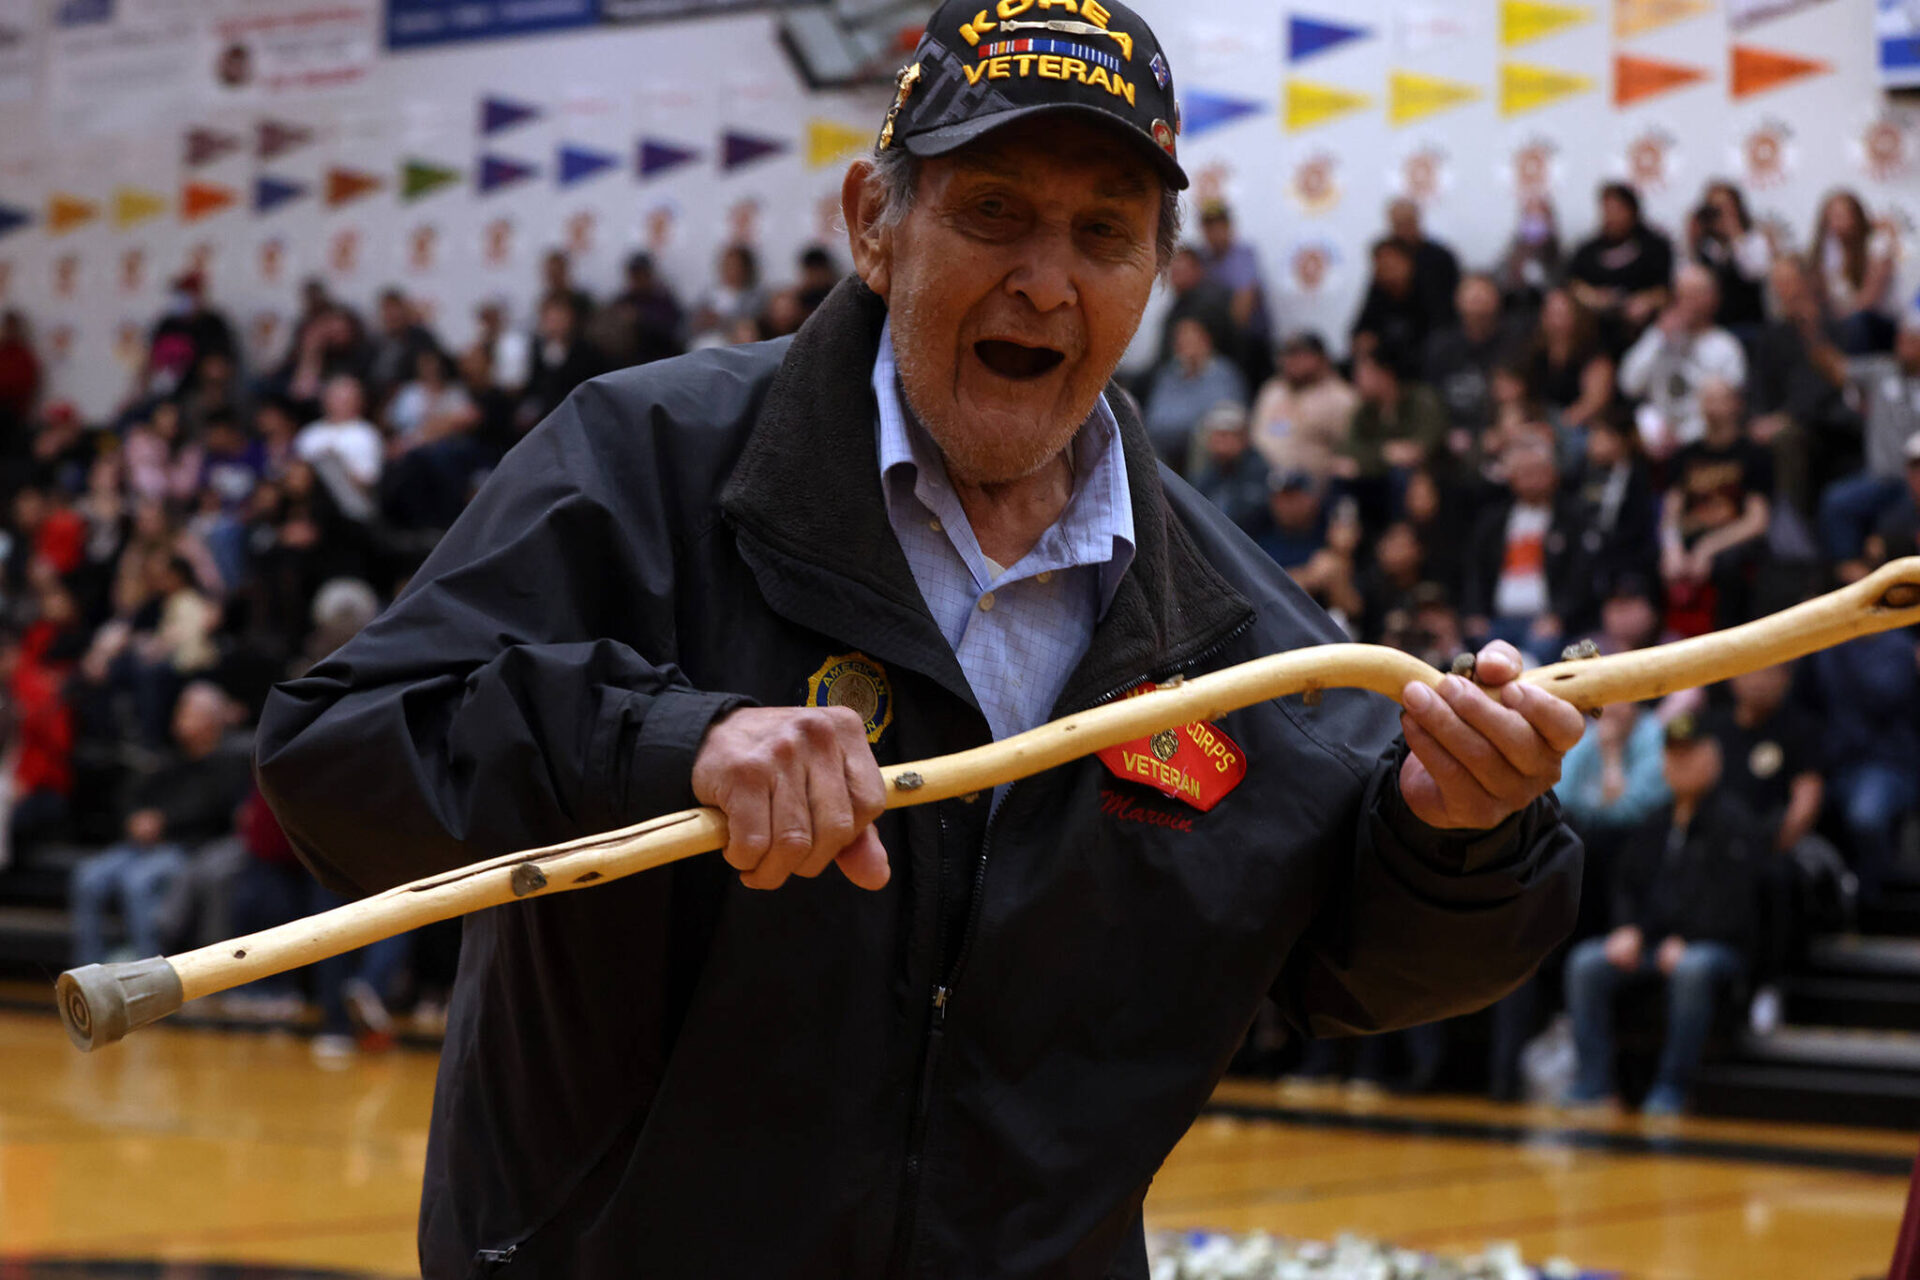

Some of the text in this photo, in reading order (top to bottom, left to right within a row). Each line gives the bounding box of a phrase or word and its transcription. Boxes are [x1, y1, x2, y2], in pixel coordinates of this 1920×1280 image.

[962, 54, 1135, 108] VETERAN
[1185, 720, 1236, 773] CORPS
[1122, 750, 1200, 800] VETERAN
[1101, 790, 1193, 833] Marvin
